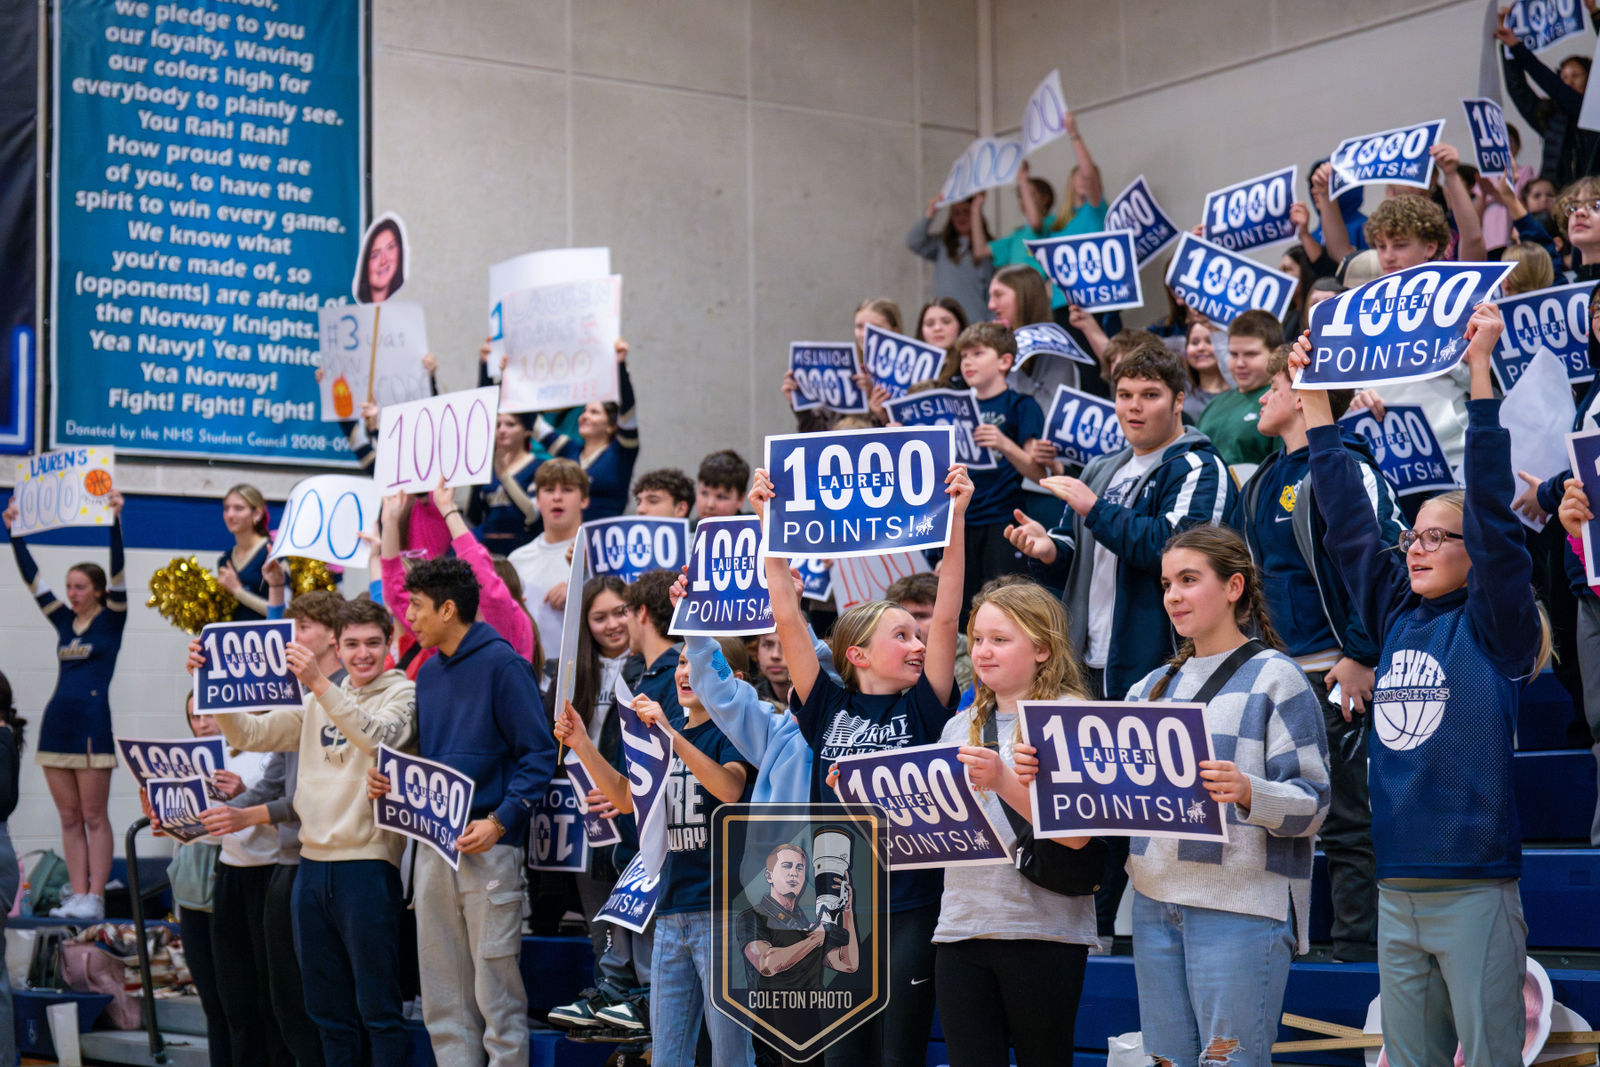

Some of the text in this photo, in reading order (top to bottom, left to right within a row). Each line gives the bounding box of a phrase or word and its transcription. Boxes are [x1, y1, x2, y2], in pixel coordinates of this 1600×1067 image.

[115, 0, 148, 17] we
[154, 3, 229, 32] pledge
[237, 16, 258, 32] to
[264, 22, 304, 40] you
[106, 27, 313, 73] our loyalty. Waving
[109, 55, 310, 93] our colors high for
[73, 77, 342, 125] everybody to plainly see.
[139, 111, 288, 145] You Rah! Rah!
[1344, 127, 1429, 168] 1000
[108, 135, 310, 175] How proud we are
[107, 164, 311, 202] of you, to have the
[76, 191, 344, 233] spirit to win every game.
[1211, 177, 1286, 234] 1000
[129, 221, 290, 254] We know what
[112, 251, 310, 283] you're made of, so
[1179, 247, 1280, 312] 1000
[76, 272, 209, 308] (opponents)
[217, 289, 250, 305] are
[257, 290, 320, 316] afraid
[1321, 271, 1481, 337] 1000
[1359, 293, 1432, 314] LAUREN
[96, 303, 321, 342] the Norway Knights.
[90, 331, 130, 350] Yea
[138, 334, 204, 360] Navy!
[213, 340, 250, 360] Yea
[866, 333, 934, 384] 1000
[1315, 338, 1441, 373] POINTS!
[141, 363, 277, 394] Yea Norway!
[794, 368, 858, 407] 1000
[109, 389, 314, 423] Fight! Fight! Fight!
[66, 421, 115, 437] Donated
[120, 426, 135, 439] by
[141, 427, 158, 440] the
[164, 428, 192, 441] NHS
[200, 429, 242, 444] Student
[248, 432, 286, 446] Council
[386, 398, 490, 488] 1000
[1055, 399, 1126, 454] 100
[30, 449, 87, 477] LAUREN'S
[784, 440, 935, 512] 1000
[818, 471, 895, 490] LAUREN
[592, 524, 678, 573] 1000
[784, 515, 914, 544] POINTS!
[712, 556, 755, 571] LAUREN
[685, 598, 764, 622] POINTS!
[204, 629, 287, 680] 1000
[207, 682, 284, 703] POINTS!
[1374, 688, 1450, 702] KNIGHTS
[129, 745, 217, 779] 1000
[1043, 715, 1196, 788] 1000
[1081, 747, 1156, 764] LAUREN
[155, 786, 202, 829] 1000
[384, 758, 465, 829] 1000
[848, 758, 968, 827] 1000
[877, 791, 934, 810] LAUREN
[1053, 793, 1186, 823] POINTS!
[385, 805, 453, 849] POINTS!
